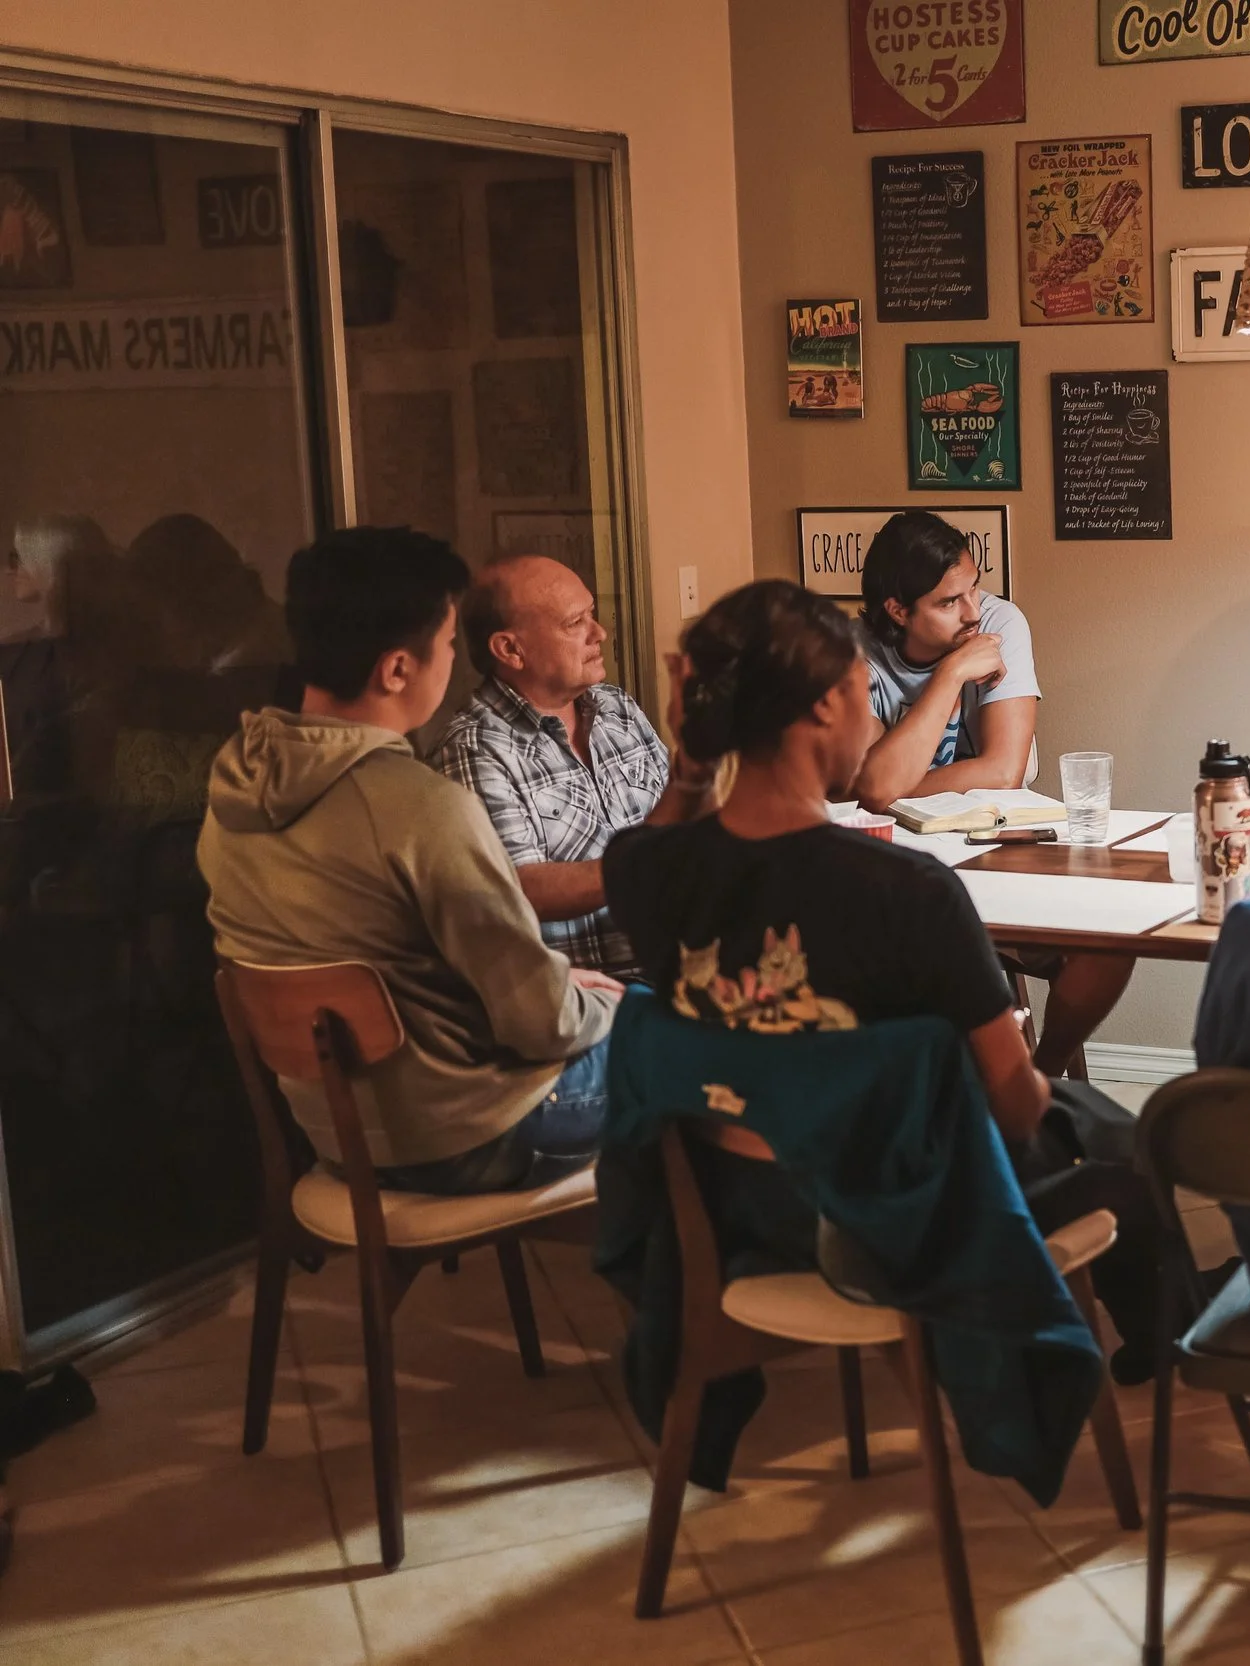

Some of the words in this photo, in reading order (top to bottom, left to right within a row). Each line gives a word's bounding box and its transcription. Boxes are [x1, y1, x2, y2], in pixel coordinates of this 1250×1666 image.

[873, 0, 1001, 30] HOSTESS
[1118, 0, 1197, 55] Cool
[875, 33, 921, 53] CUP
[928, 27, 1000, 49] CAKES
[894, 63, 906, 86] 2
[909, 68, 927, 85] for
[925, 54, 959, 112] 5
[957, 64, 987, 82] Cents
[1040, 144, 1060, 153] NEW
[1084, 142, 1126, 150] WRAPPED
[1028, 152, 1096, 170] Cracker
[1097, 149, 1140, 167] Jack
[888, 164, 916, 174] Recipe
[918, 162, 932, 172] For
[934, 162, 965, 172] Success
[887, 300, 901, 308] and
[908, 300, 920, 310] Bag
[922, 298, 930, 311] of
[789, 302, 855, 336] HOT
[820, 322, 859, 337] BRAND
[1061, 382, 1089, 399] Recipe
[1093, 381, 1109, 396] For
[1112, 382, 1156, 398] Happiness
[931, 417, 958, 431] SEA
[961, 416, 995, 430] FOOD
[1069, 414, 1080, 425] Bag
[1083, 412, 1091, 426] of
[939, 432, 953, 441] Our
[955, 432, 989, 442] Specialty
[1065, 520, 1080, 528] and
[1088, 520, 1110, 528] Packet
[1112, 519, 1120, 533] of
[1121, 520, 1134, 531] Life
[812, 532, 863, 573] GRACE
